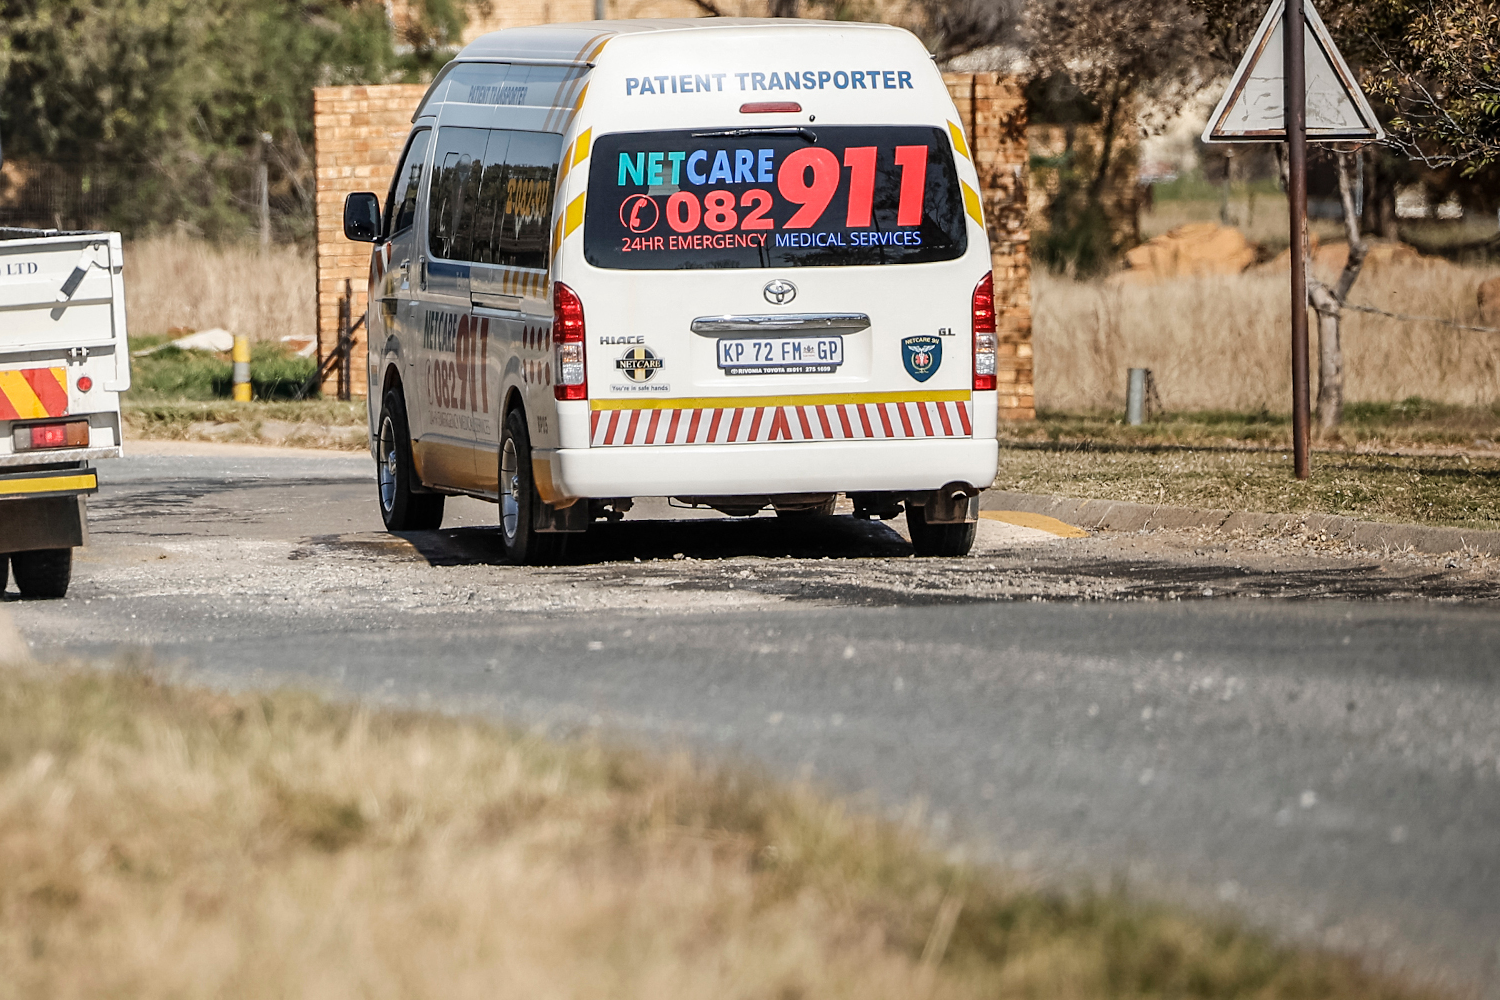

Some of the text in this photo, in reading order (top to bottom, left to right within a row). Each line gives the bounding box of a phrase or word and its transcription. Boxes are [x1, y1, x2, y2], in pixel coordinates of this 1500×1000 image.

[625, 70, 914, 96] PATIENT TRANSPORTER
[617, 145, 929, 230] NETCARE 911
[665, 189, 775, 233] 082
[621, 230, 922, 252] 24HR EMERGENCY MEDICAL SERVICES
[6, 261, 40, 277] LTD
[599, 335, 645, 345] HIACE
[938, 327, 956, 337] GL
[423, 310, 489, 414] NETCARE 911
[723, 340, 838, 362] KP 72 FM GP
[619, 360, 661, 369] NETCARE
[433, 358, 458, 409] 082
